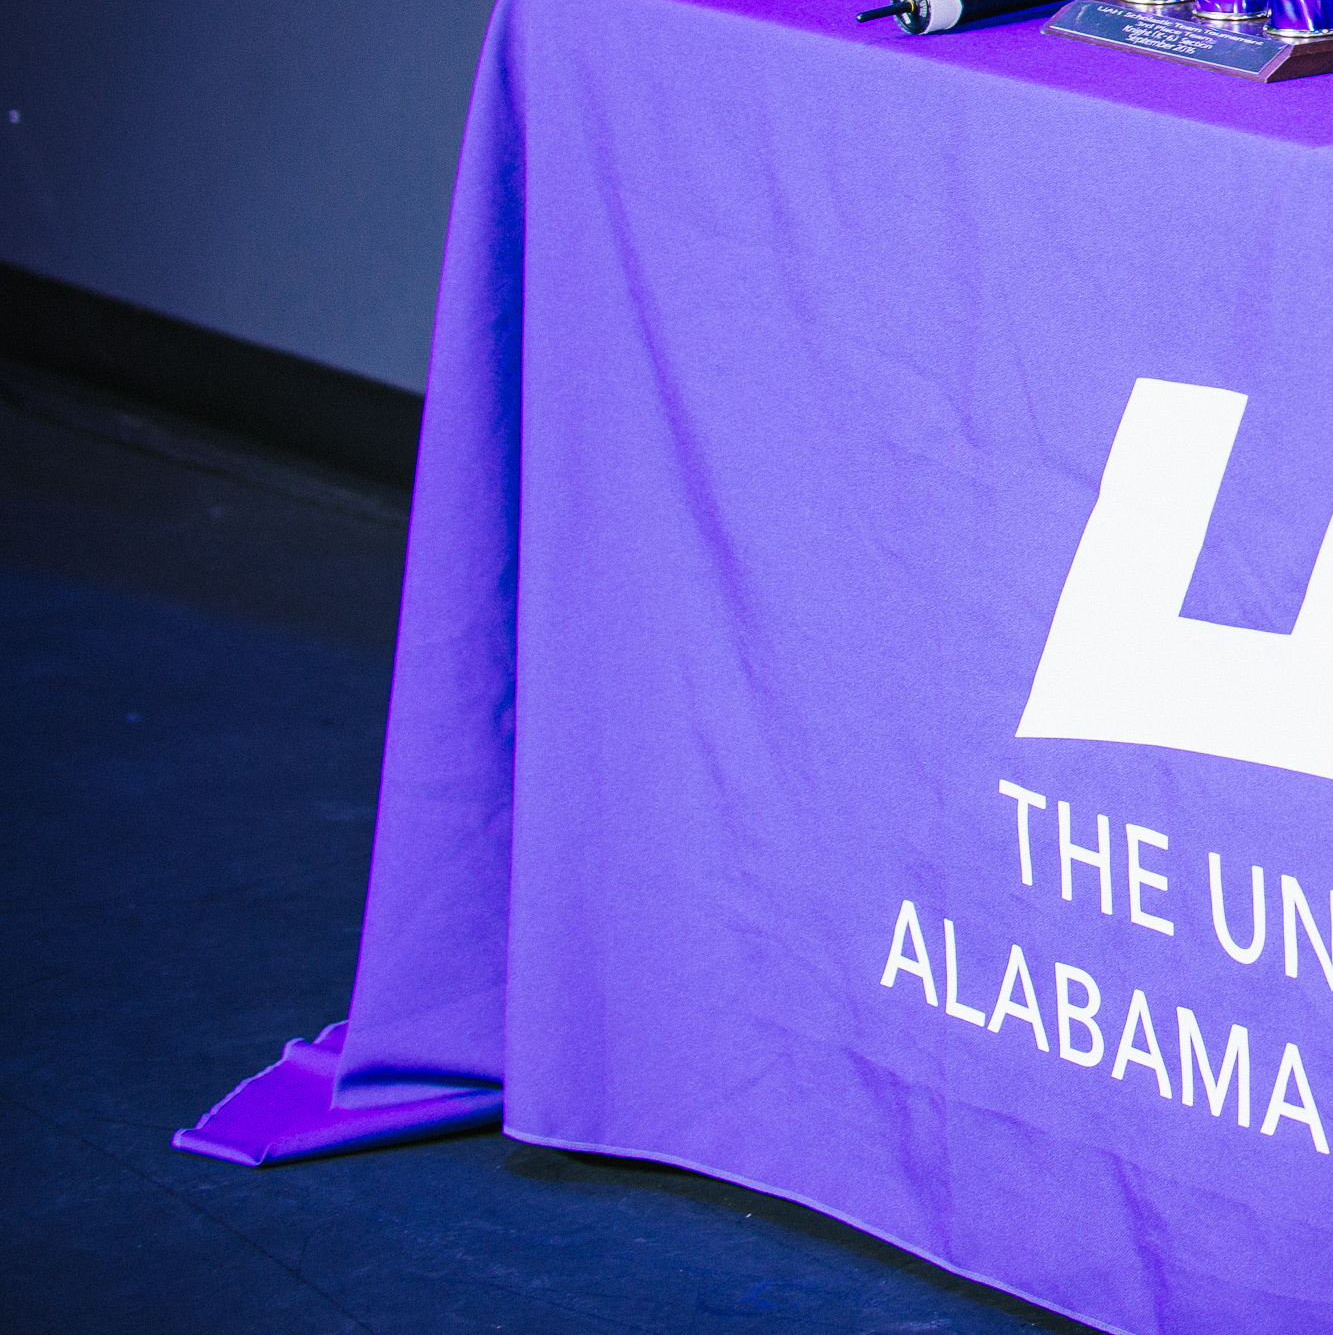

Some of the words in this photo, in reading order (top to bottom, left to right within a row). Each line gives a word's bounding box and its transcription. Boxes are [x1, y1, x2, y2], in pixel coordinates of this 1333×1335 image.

[1097, 6, 1122, 14] UAH
[1123, 11, 1173, 25] Scholastic
[1174, 22, 1202, 31] Team
[1204, 29, 1263, 45] Tournament
[1122, 24, 1153, 36] Knight
[1150, 31, 1179, 41] (K-6)
[1179, 37, 1214, 48] Section
[1153, 25, 1182, 33] Place
[1184, 31, 1214, 40] Team
[1124, 33, 1175, 51] September
[1172, 44, 1196, 53] 2016
[999, 779, 1172, 935] THE
[881, 900, 1327, 1155] ALABAMA
